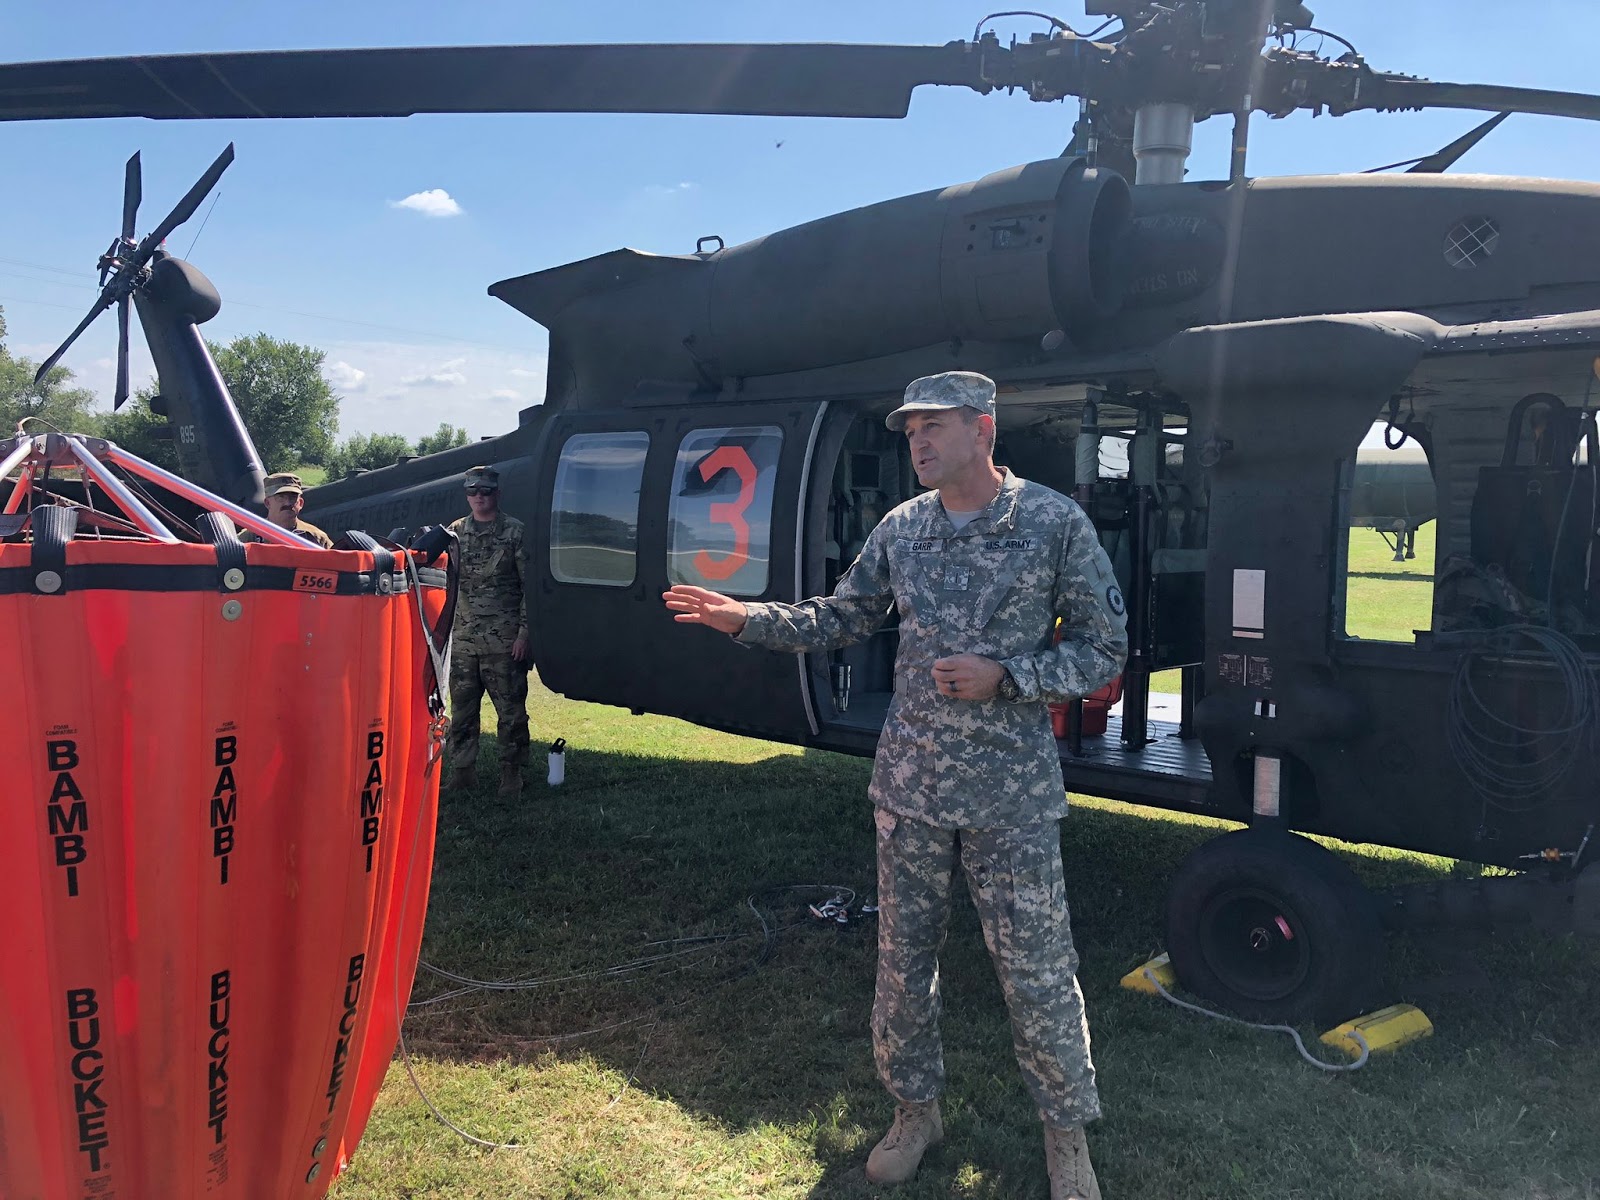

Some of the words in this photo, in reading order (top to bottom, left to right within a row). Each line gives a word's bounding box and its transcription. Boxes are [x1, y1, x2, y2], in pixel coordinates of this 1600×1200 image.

[180, 425, 195, 443] 895
[300, 575, 332, 589] 5566
[693, 446, 758, 580] 3
[912, 542, 932, 551] GARR
[1005, 540, 1031, 549] ARMY
[210, 736, 237, 885] BAMBI
[361, 731, 384, 873] BAMBI
[46, 740, 88, 896] BAMBI
[67, 988, 109, 1172] BUCKET
[208, 969, 231, 1144] BUCKET
[326, 953, 364, 1114] BUCKET
